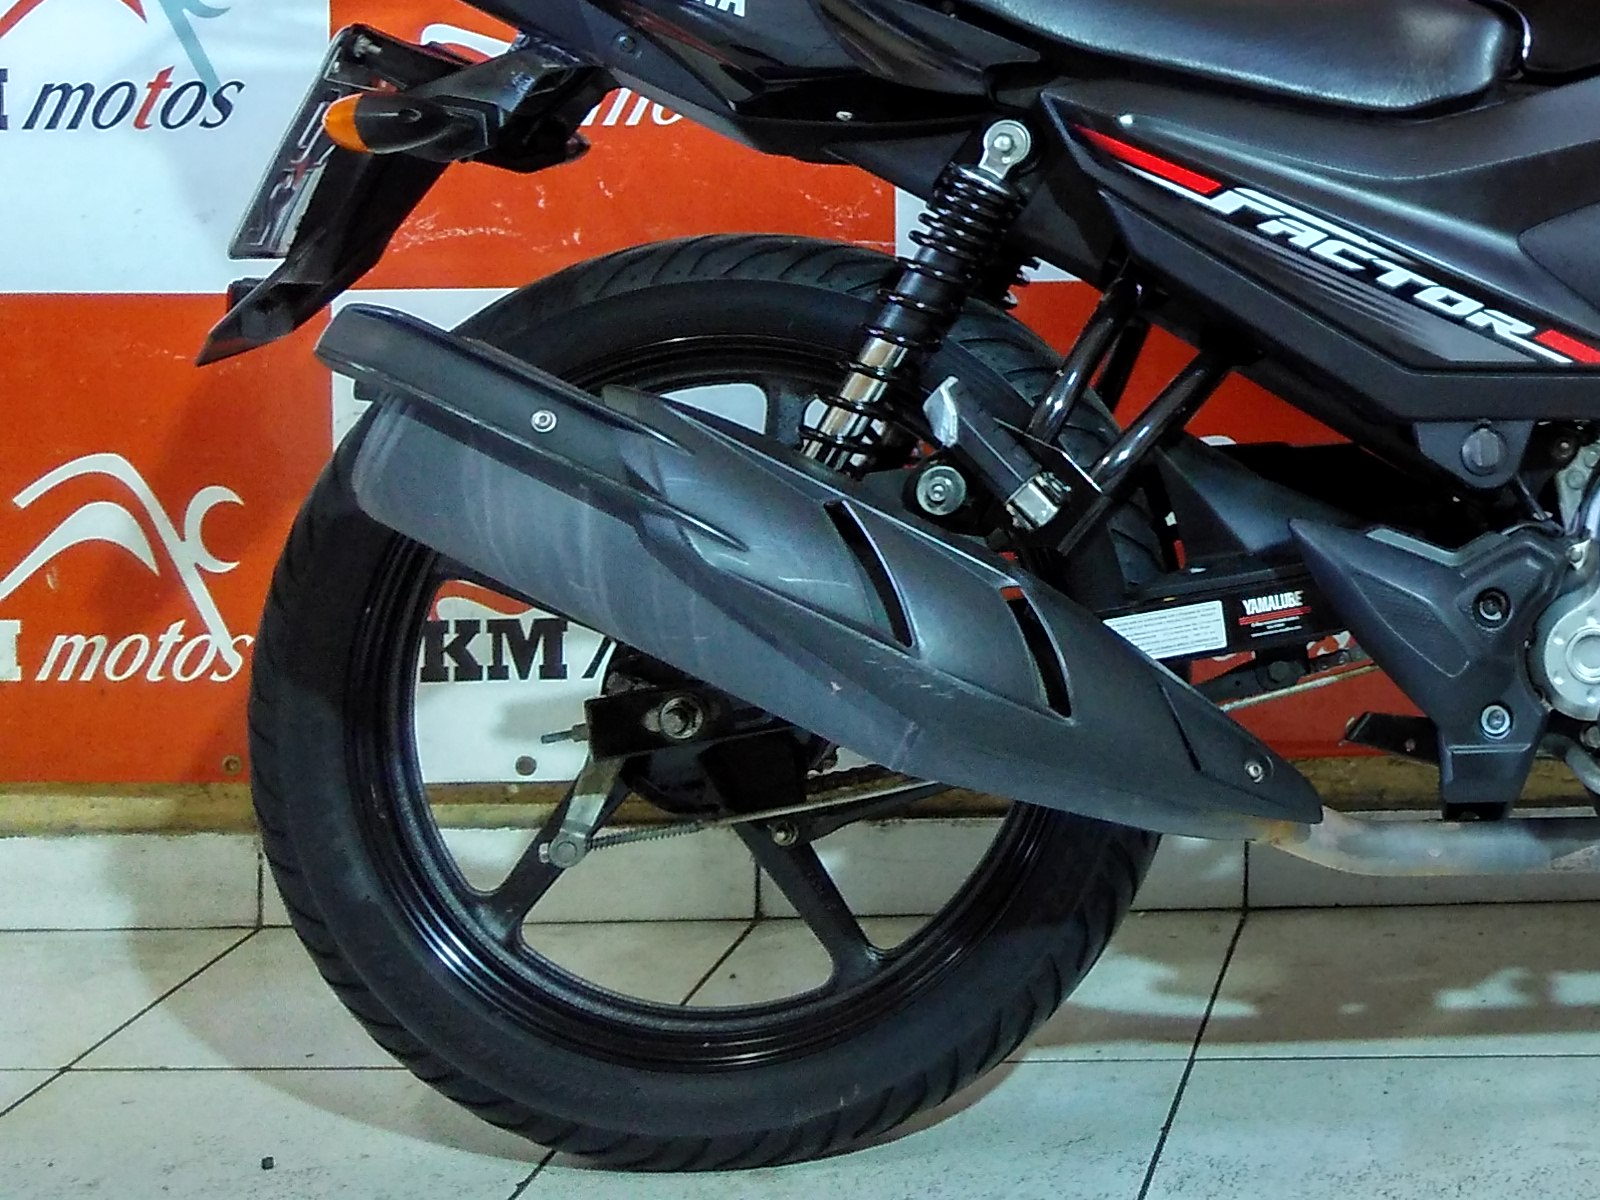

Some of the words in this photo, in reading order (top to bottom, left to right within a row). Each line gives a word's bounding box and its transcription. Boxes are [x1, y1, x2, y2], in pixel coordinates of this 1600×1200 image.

[22, 66, 246, 131] motos
[1205, 187, 1575, 364] FACTOR
[1242, 589, 1304, 616] YAMALUBE
[35, 619, 254, 682] motos
[420, 617, 568, 682] KM
